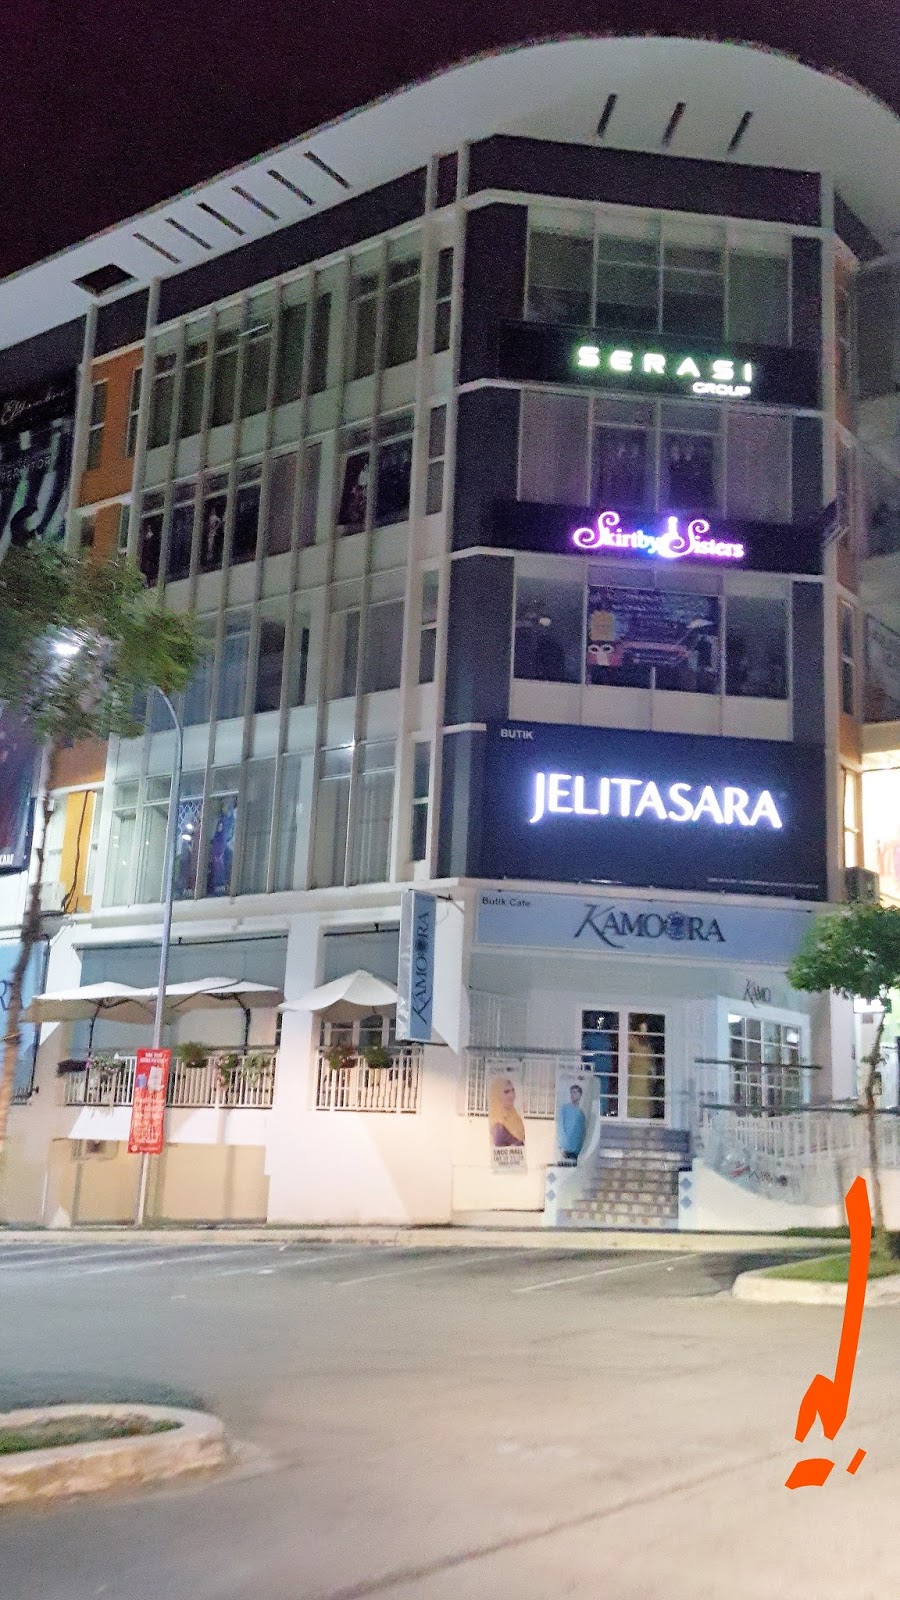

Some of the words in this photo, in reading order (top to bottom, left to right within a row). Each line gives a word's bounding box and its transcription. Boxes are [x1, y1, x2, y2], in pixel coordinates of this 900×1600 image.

[577, 346, 754, 382] SERASI
[692, 381, 752, 397] GROUP
[572, 510, 660, 554] Skirtby
[670, 518, 746, 559] Sisters
[500, 728, 534, 741] BUTIK
[529, 771, 783, 829] JELITASARA
[481, 896, 507, 906] Butik
[509, 898, 531, 908] Cafe
